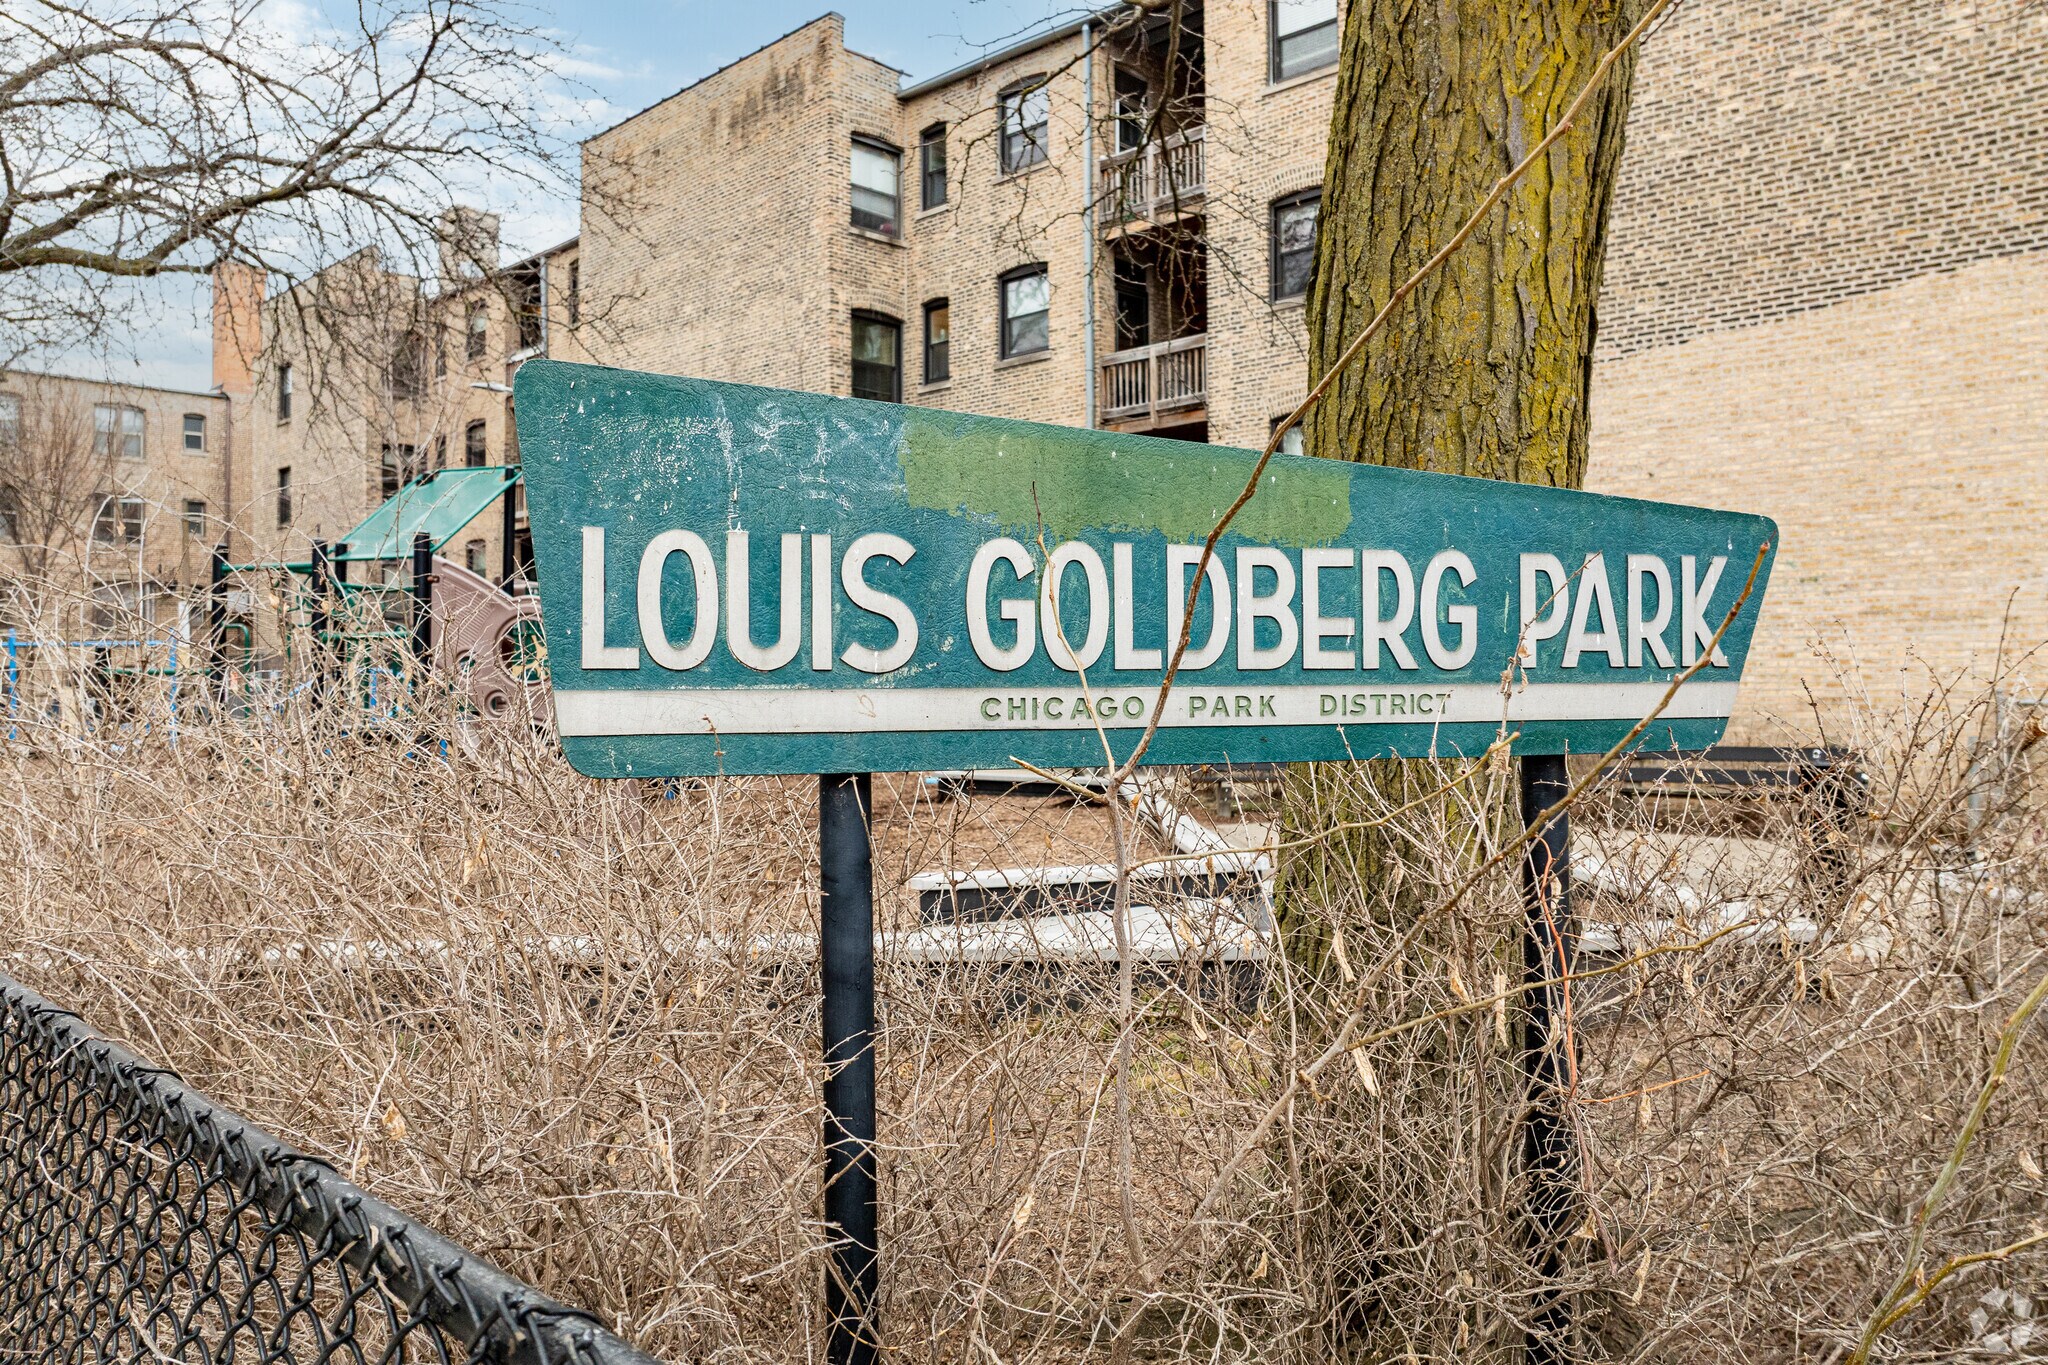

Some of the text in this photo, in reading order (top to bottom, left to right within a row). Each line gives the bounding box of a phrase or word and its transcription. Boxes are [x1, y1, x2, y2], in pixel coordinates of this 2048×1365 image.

[581, 526, 1730, 674] LOUIS GOLDBERG PARK
[980, 693, 1452, 721] CHICAGO PARK DISTRICT
